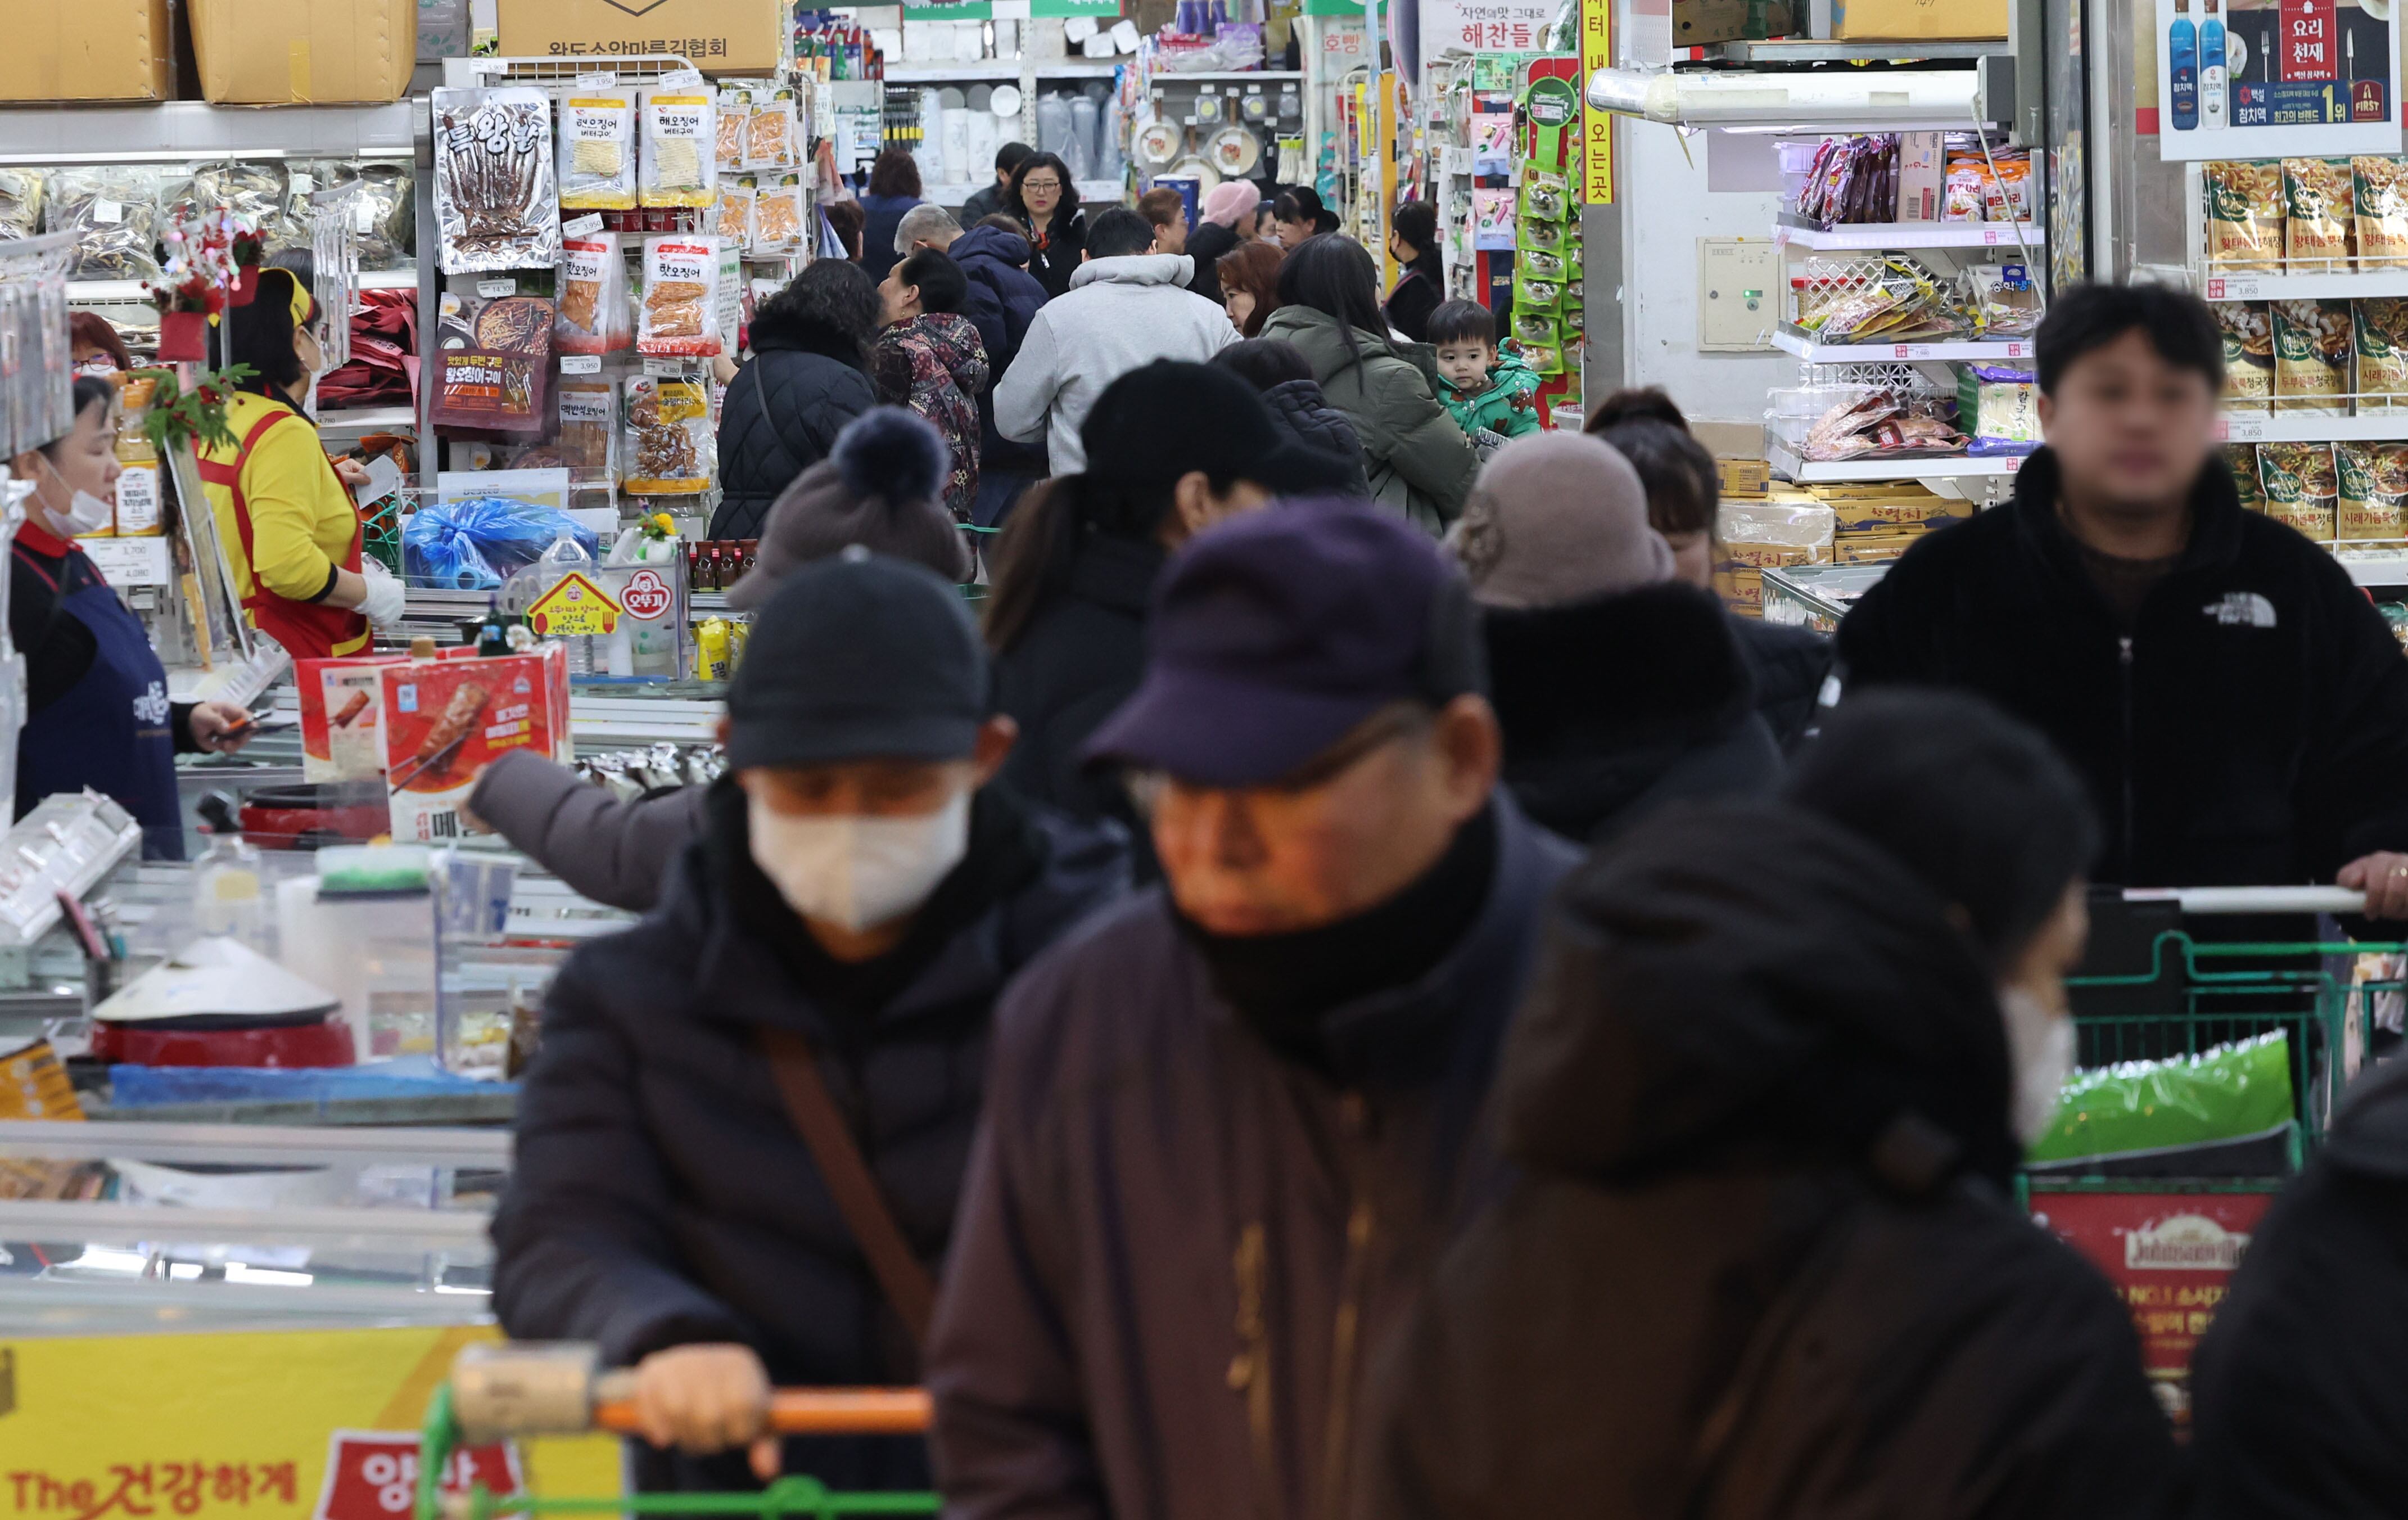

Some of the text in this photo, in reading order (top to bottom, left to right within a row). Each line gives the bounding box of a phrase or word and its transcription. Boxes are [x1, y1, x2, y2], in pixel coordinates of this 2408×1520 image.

[1513, 8, 1546, 19] 그대로
[1462, 22, 1532, 48] 해찬들
[2293, 18, 2323, 38] 요리
[1323, 34, 1360, 54] 호빵
[2293, 42, 2324, 63] 천재
[682, 75, 699, 84] 3,950
[2251, 89, 2265, 102] 백설
[2322, 84, 2346, 123] 1위
[2355, 100, 2379, 112] FIRST
[659, 116, 699, 127] 해오징어
[2239, 107, 2266, 123] 참치액
[2274, 110, 2319, 123] 최고의 브랜드
[584, 220, 601, 231] 3,950
[659, 263, 701, 278] 핫오징어
[447, 355, 468, 366] 맛있게
[470, 355, 485, 367] 두번
[629, 593, 663, 608] 오뚜기
[8, 1460, 297, 1517] The 건강하게
